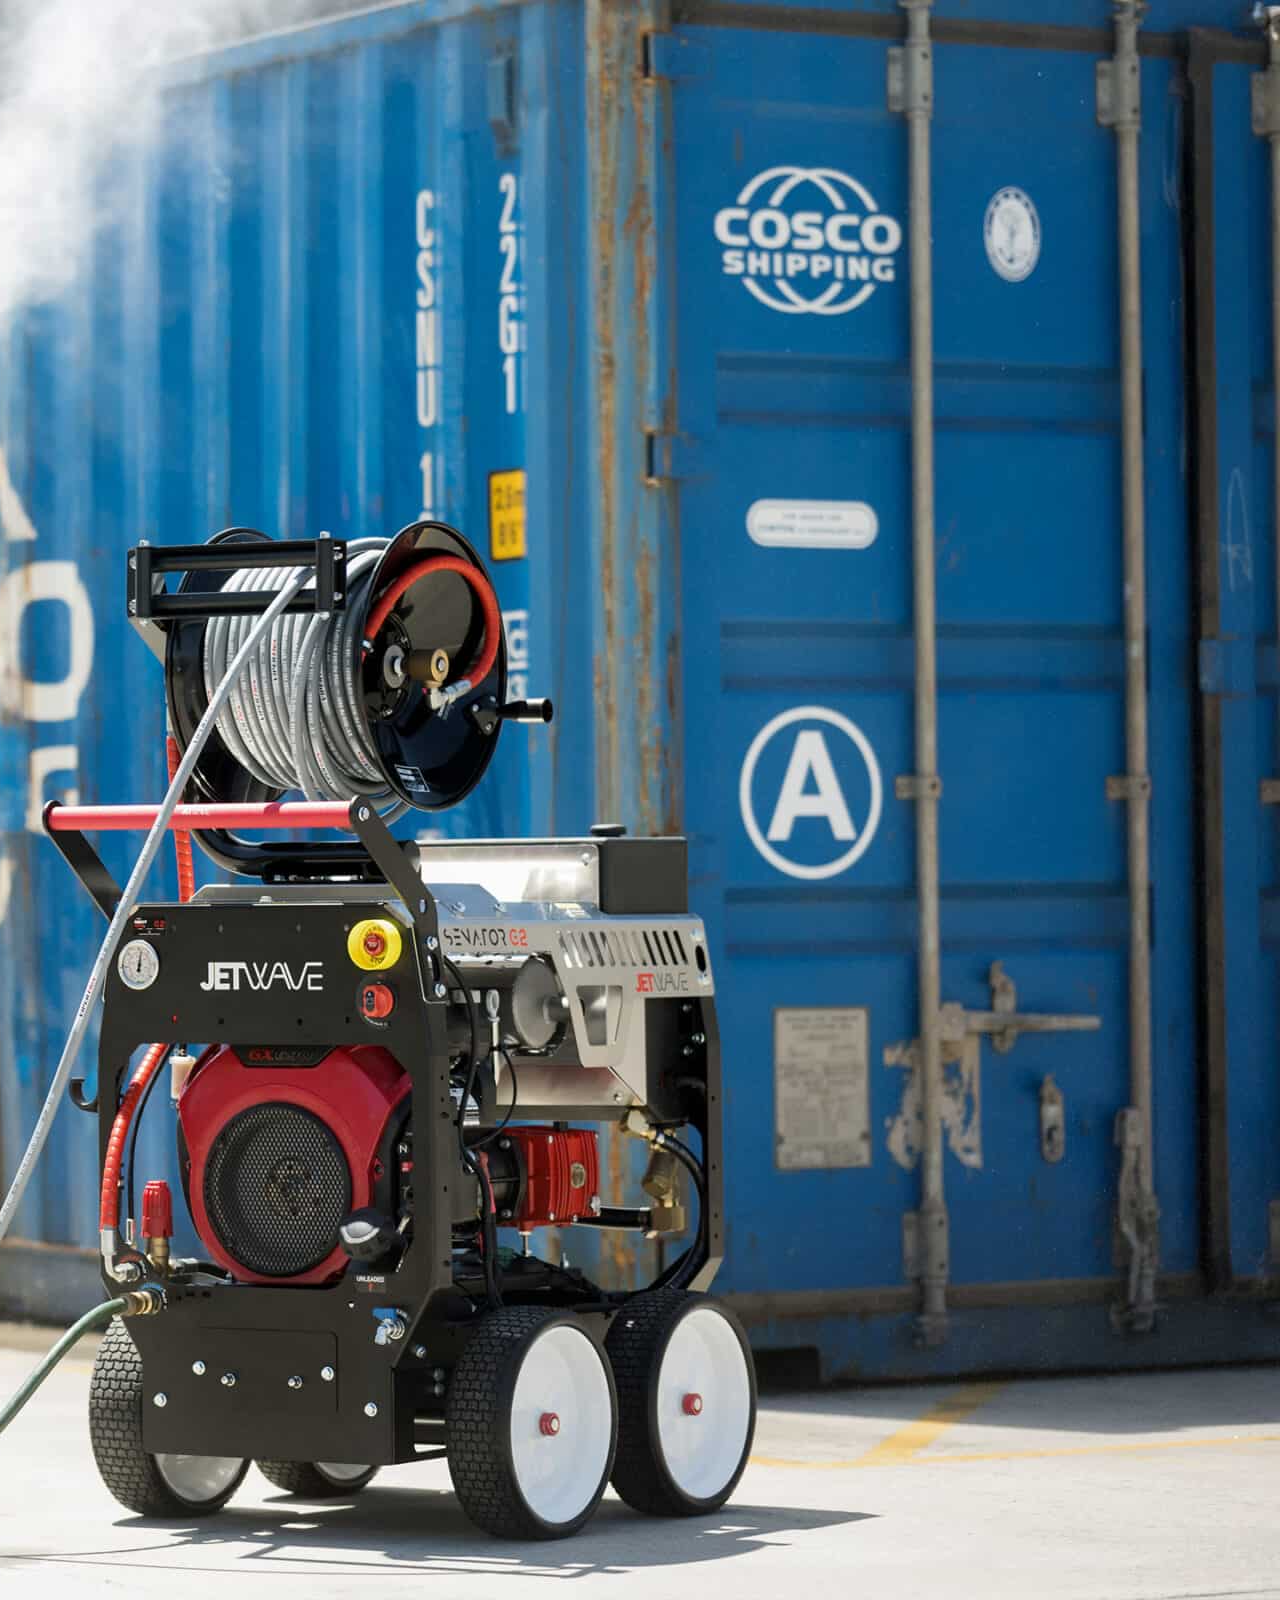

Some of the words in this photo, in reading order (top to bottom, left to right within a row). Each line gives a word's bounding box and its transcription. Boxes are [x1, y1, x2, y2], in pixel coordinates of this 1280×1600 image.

[713, 207, 902, 255] COSCO
[722, 250, 896, 282] SHIPPING
[415, 188, 437, 428] CSNU
[498, 172, 520, 415] 22G1
[766, 730, 857, 841] A
[509, 927, 529, 947] G2
[200, 961, 324, 991] JETWAVE
[635, 972, 689, 993] JETWAVE
